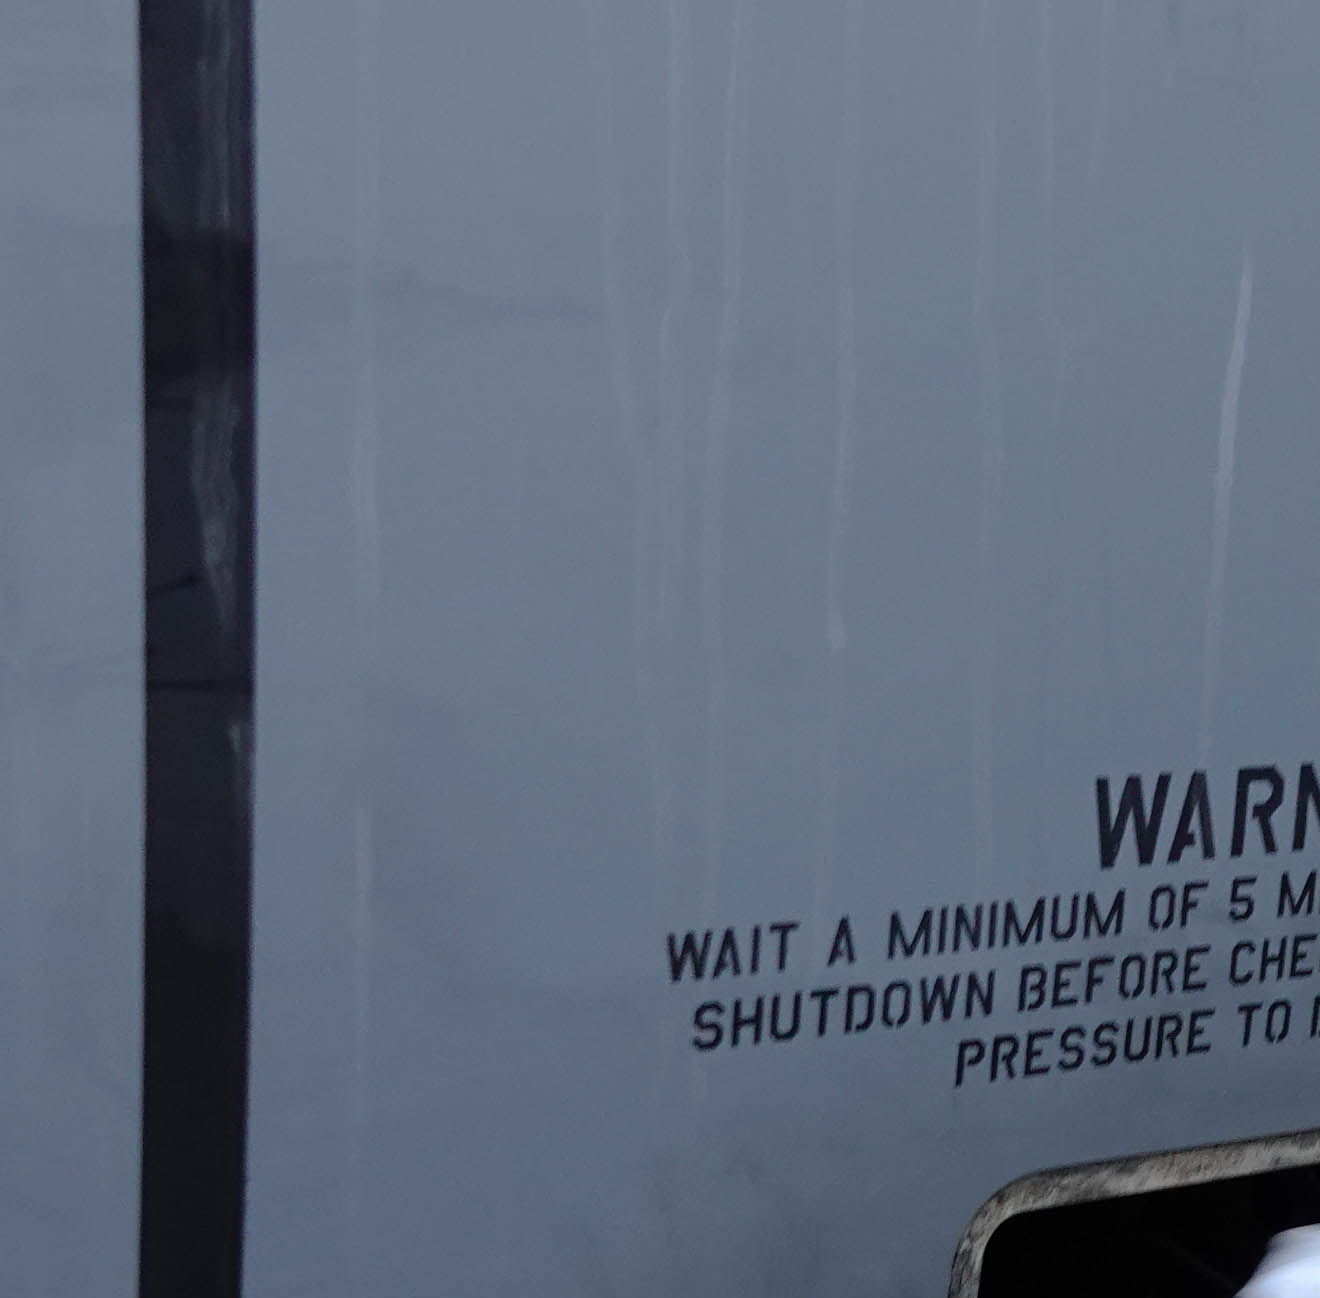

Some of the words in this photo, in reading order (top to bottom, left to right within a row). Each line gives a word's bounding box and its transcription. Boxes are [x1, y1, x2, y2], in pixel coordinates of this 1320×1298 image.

[666, 921, 800, 983] WAIT
[826, 914, 857, 967] A
[887, 888, 1126, 961] MINIMUM
[1147, 880, 1209, 931] OF
[1228, 876, 1258, 924] 5
[691, 969, 996, 1052] SHUTDOWN
[1016, 944, 1211, 1013] BEFORE
[954, 1008, 1216, 1088] PRESSURE
[1237, 999, 1293, 1047] TO
